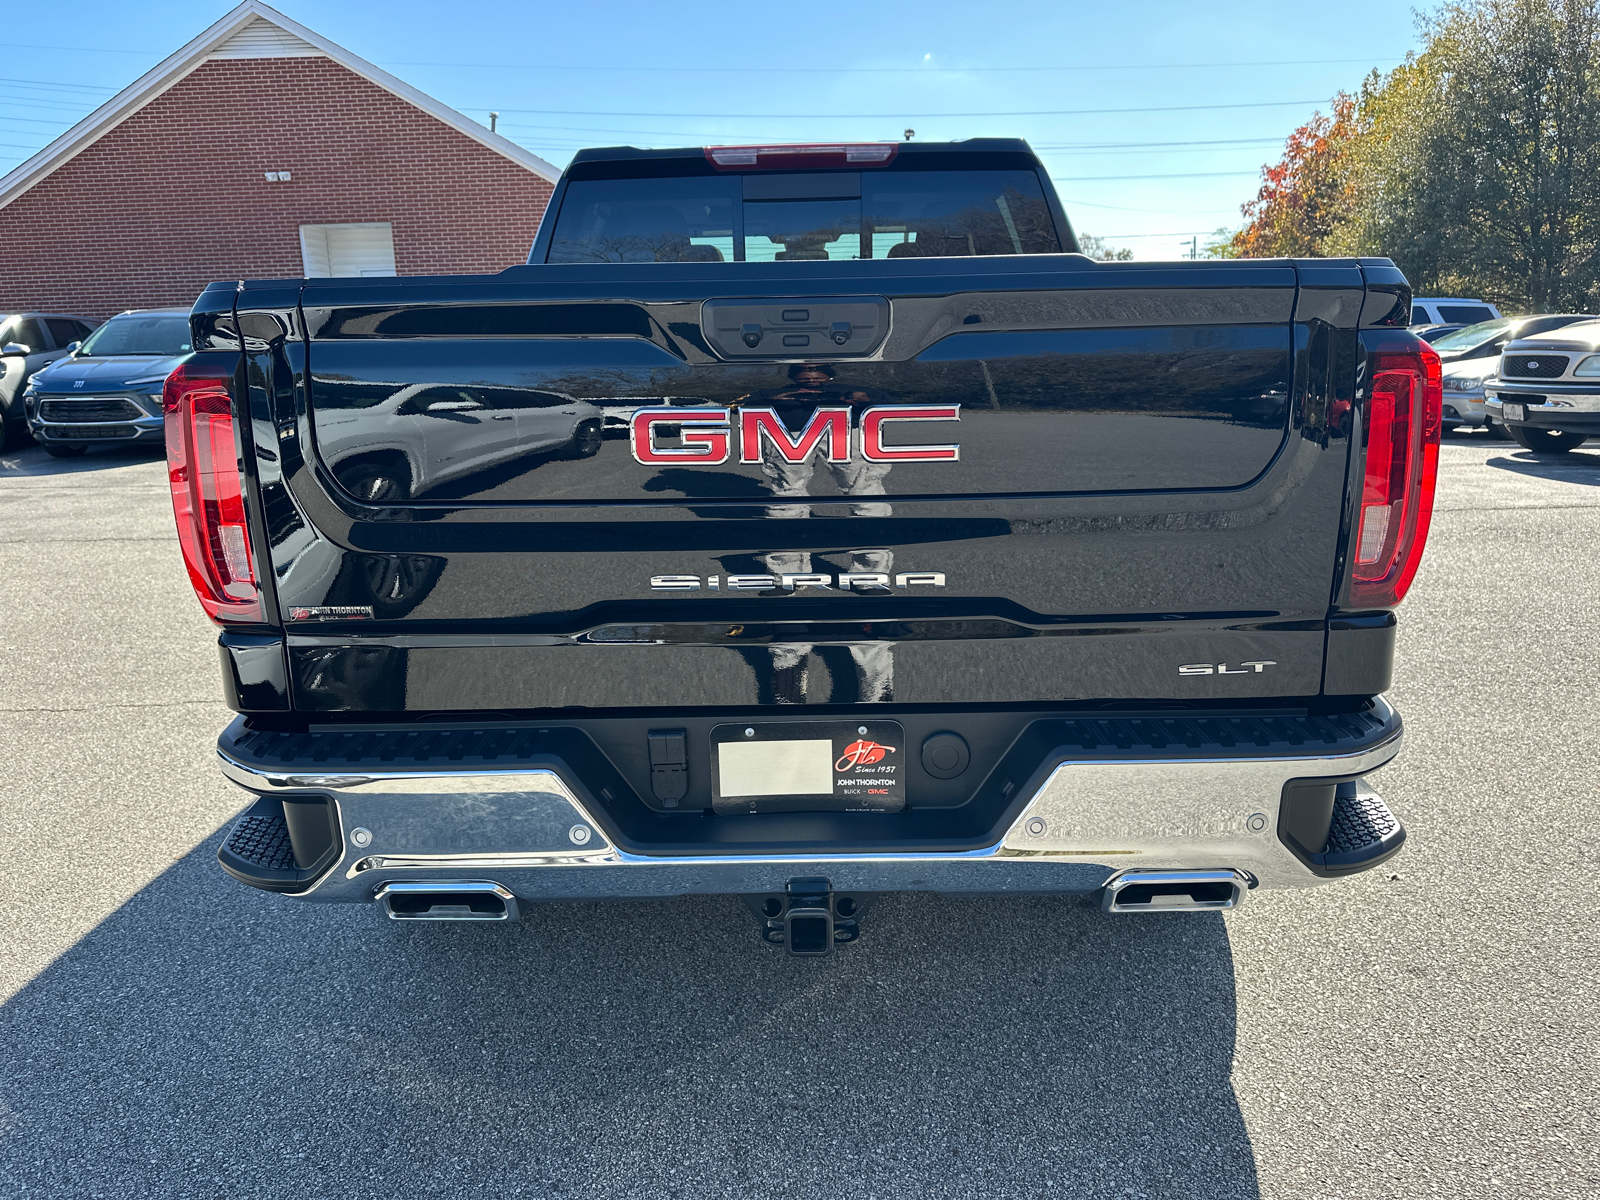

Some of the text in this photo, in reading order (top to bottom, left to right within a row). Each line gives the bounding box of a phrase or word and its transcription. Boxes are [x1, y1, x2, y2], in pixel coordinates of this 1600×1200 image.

[630, 403, 961, 466] GMC
[650, 571, 946, 591] SIERRA
[311, 606, 372, 615] JOHN THORNTON
[1178, 660, 1277, 676] SLT
[854, 765, 896, 773] Since 1957
